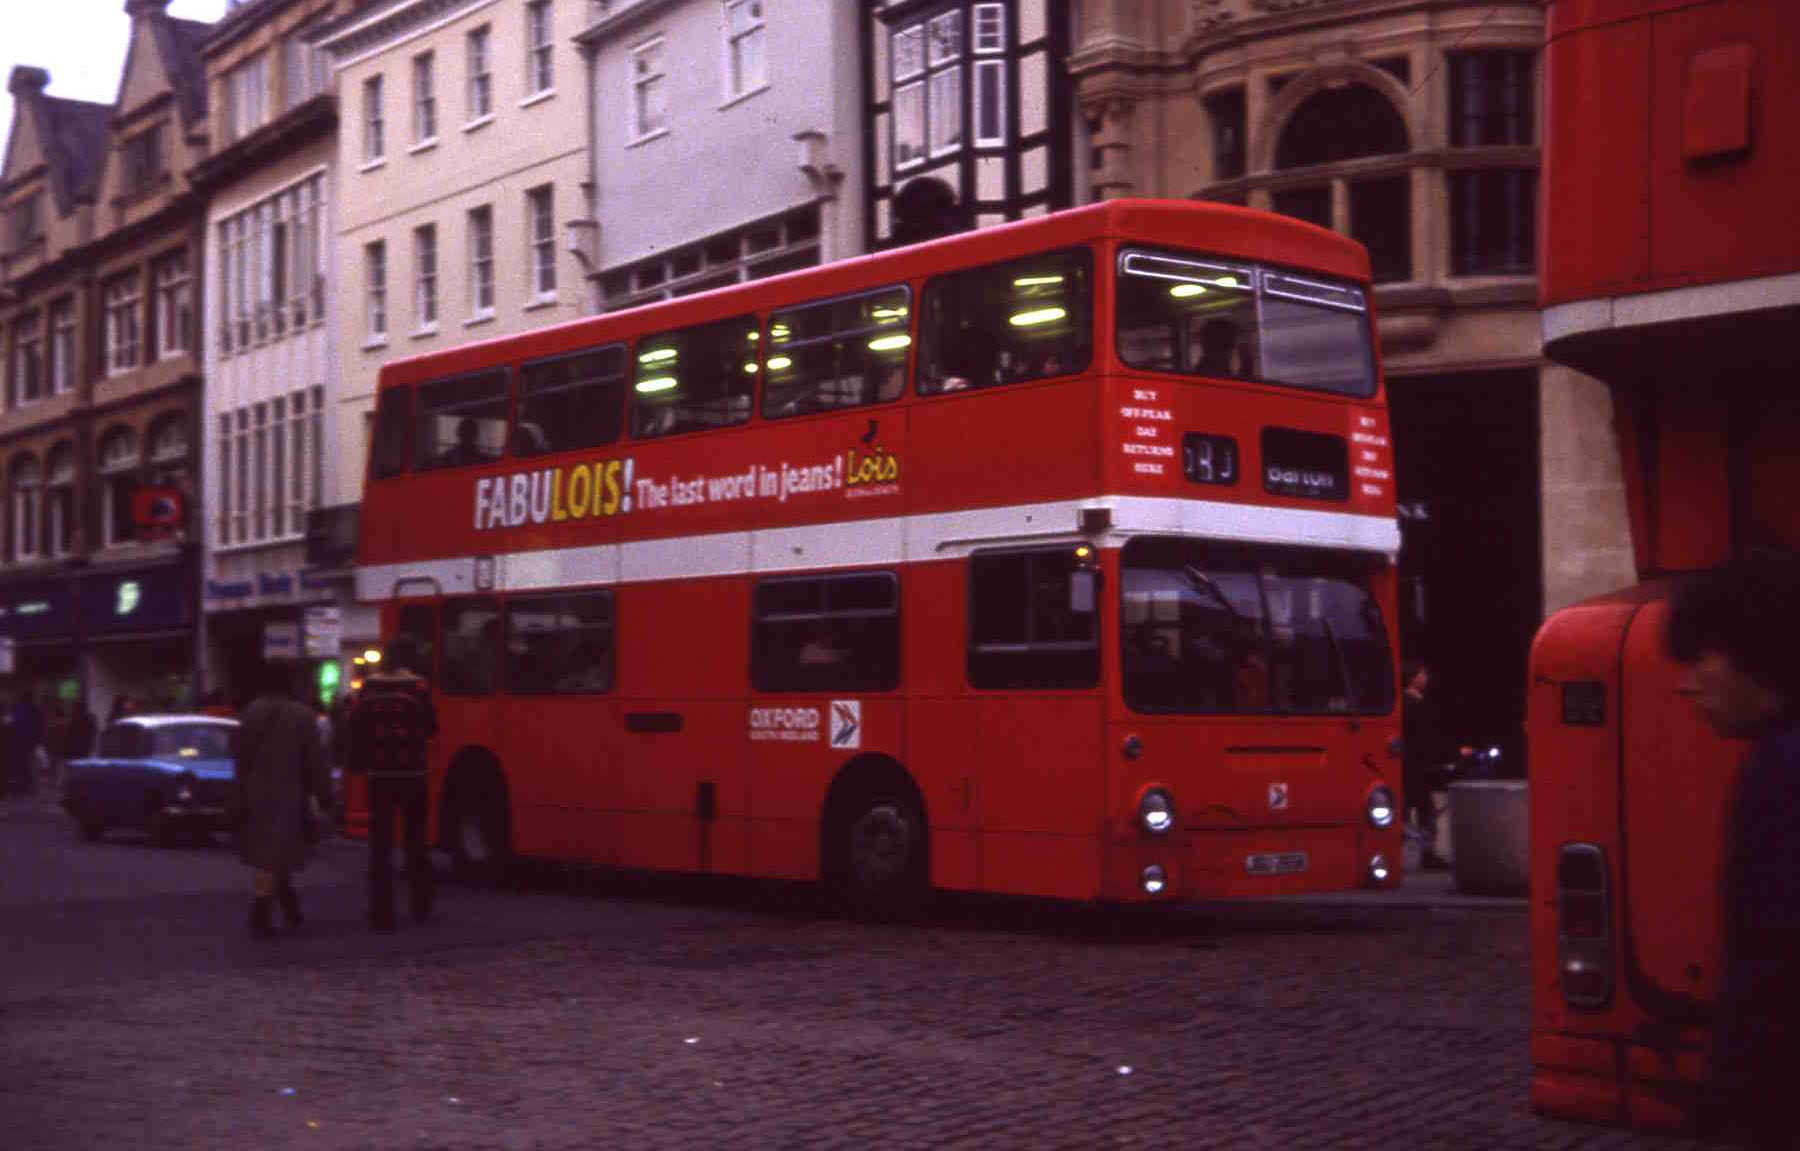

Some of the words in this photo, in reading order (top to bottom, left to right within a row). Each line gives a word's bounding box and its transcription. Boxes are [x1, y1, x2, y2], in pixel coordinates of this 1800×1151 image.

[846, 447, 898, 484] Lois
[473, 458, 634, 530] FABULOIS!
[636, 477, 669, 509] The
[671, 475, 704, 505] last
[707, 465, 756, 501] word
[759, 465, 778, 497] in
[779, 454, 842, 502] jeans!
[751, 708, 819, 728] OXFORD
